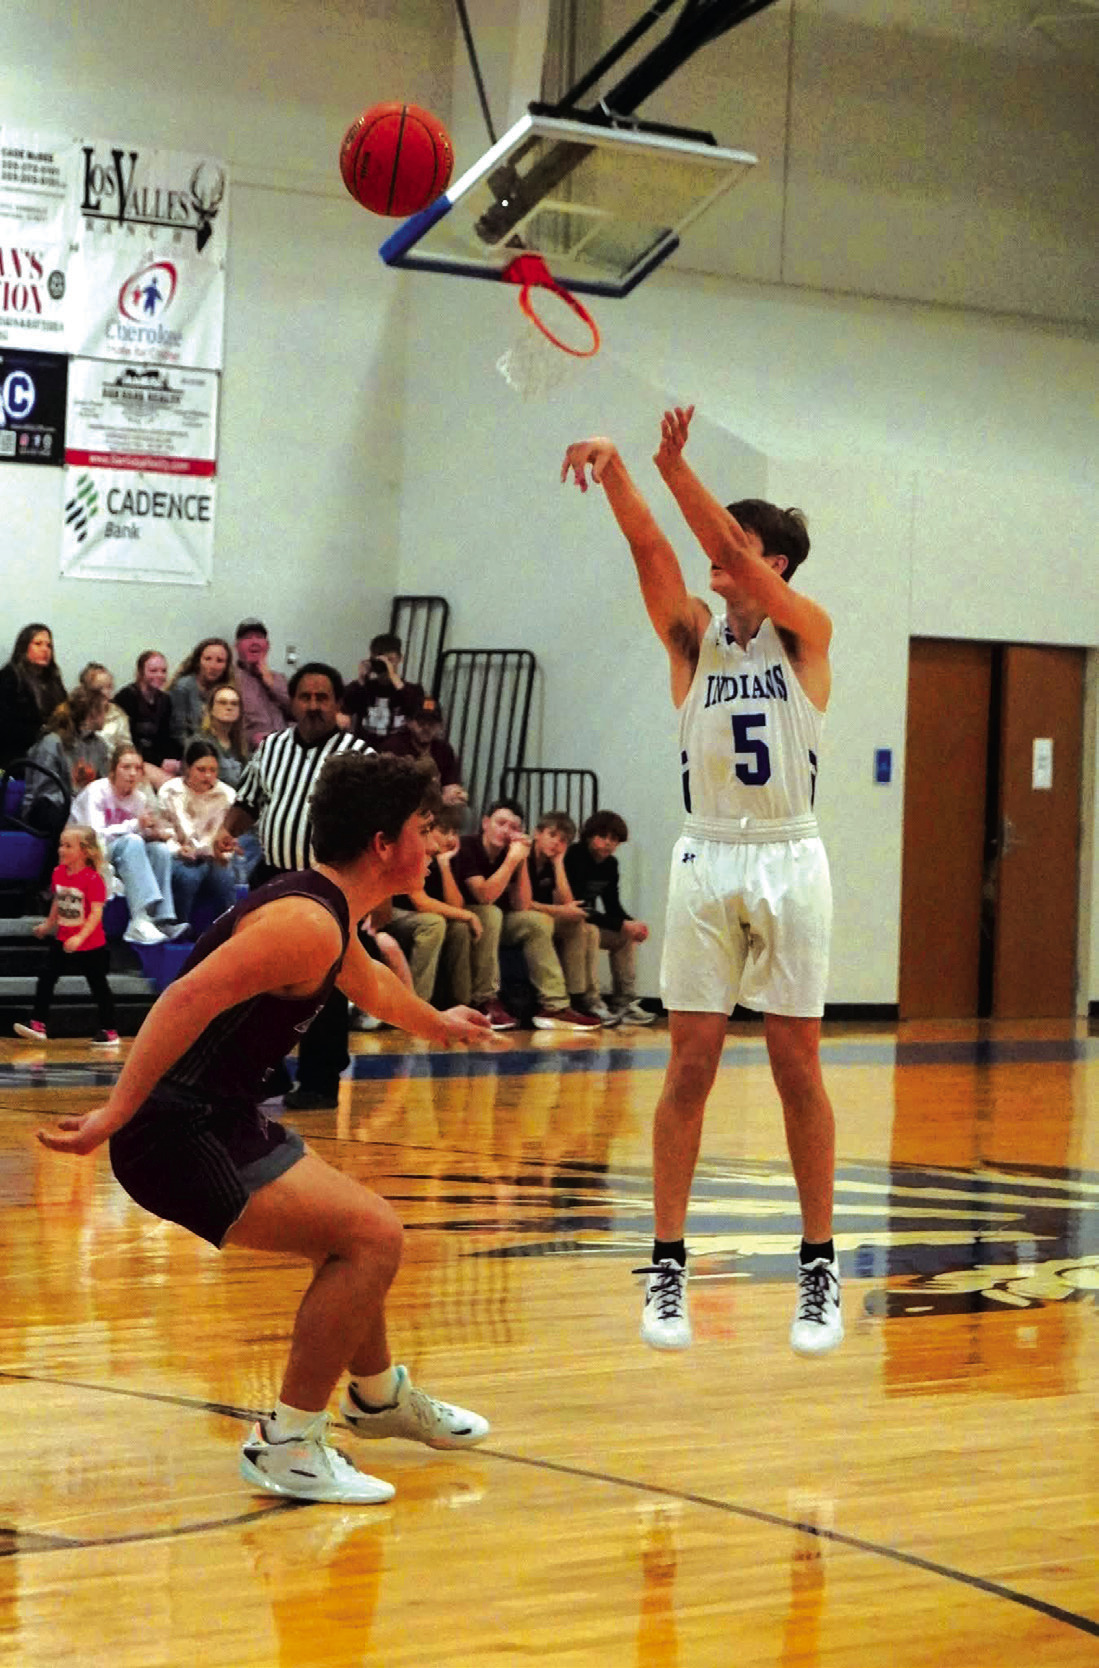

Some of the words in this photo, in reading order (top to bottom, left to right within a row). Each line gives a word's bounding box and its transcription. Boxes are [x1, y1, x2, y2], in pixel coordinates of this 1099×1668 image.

[106, 488, 211, 522] CADENCE
[103, 521, 141, 540] Bank
[704, 664, 788, 709] INDIANS
[731, 713, 772, 786] 5
